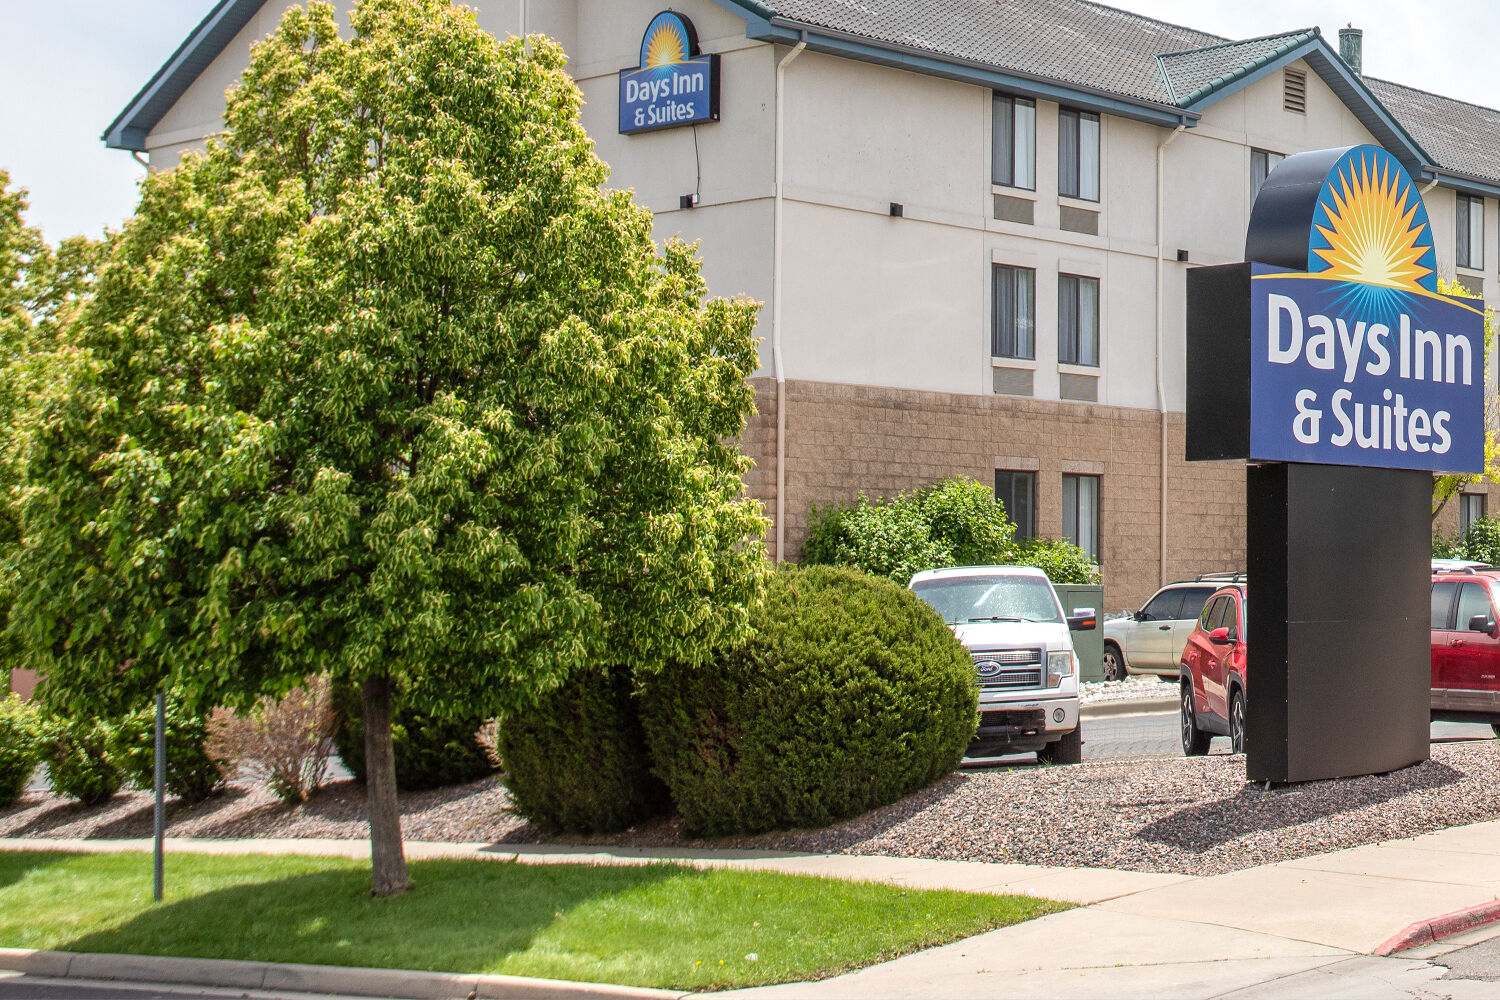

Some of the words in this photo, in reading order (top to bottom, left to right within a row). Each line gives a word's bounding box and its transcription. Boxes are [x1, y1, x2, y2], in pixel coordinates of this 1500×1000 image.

[626, 77, 670, 104] Days
[672, 72, 704, 96] Inn
[634, 107, 645, 127] &
[647, 100, 695, 125] Suites
[1268, 293, 1391, 384] Days
[1400, 313, 1473, 386] Inn
[1292, 388, 1322, 444] &
[1330, 388, 1452, 454] Suites
